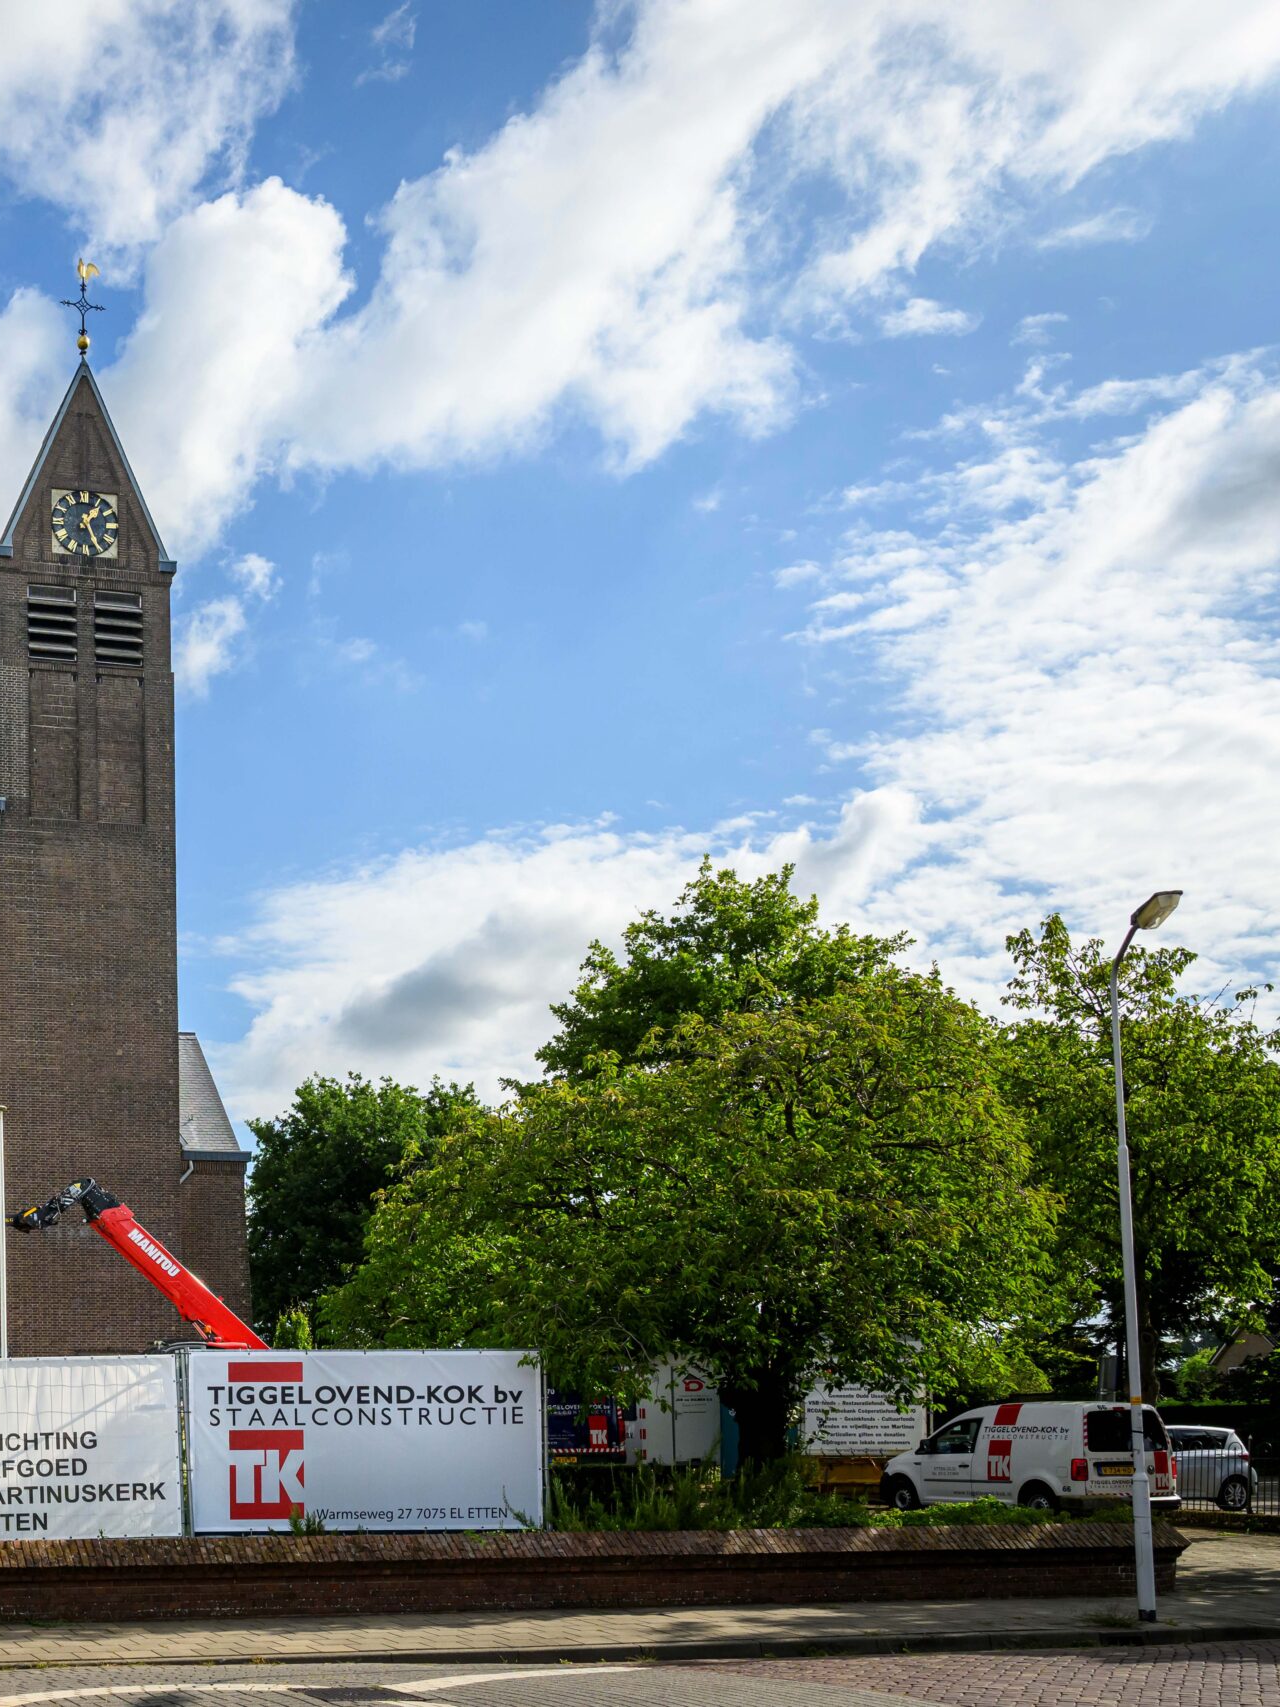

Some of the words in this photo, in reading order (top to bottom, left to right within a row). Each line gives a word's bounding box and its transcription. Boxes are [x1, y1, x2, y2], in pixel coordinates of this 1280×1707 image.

[128, 1228, 180, 1277] MANITOU
[207, 1385, 486, 1405] TIGGELOVEND-KOK
[494, 1384, 523, 1404] bv
[209, 1406, 524, 1427] STAALCONSTRUCTIE
[589, 1429, 608, 1445] TK
[984, 1426, 1058, 1434] TIGGELOVEND-KOK
[1060, 1426, 1070, 1434] bv
[988, 1455, 1011, 1477] TK
[1155, 1473, 1170, 1488] TK
[316, 1508, 394, 1522] Warmseweg
[397, 1508, 412, 1519] 27
[416, 1508, 447, 1519] 7075
[449, 1507, 464, 1519] EL
[467, 1507, 508, 1519] ETTEN
